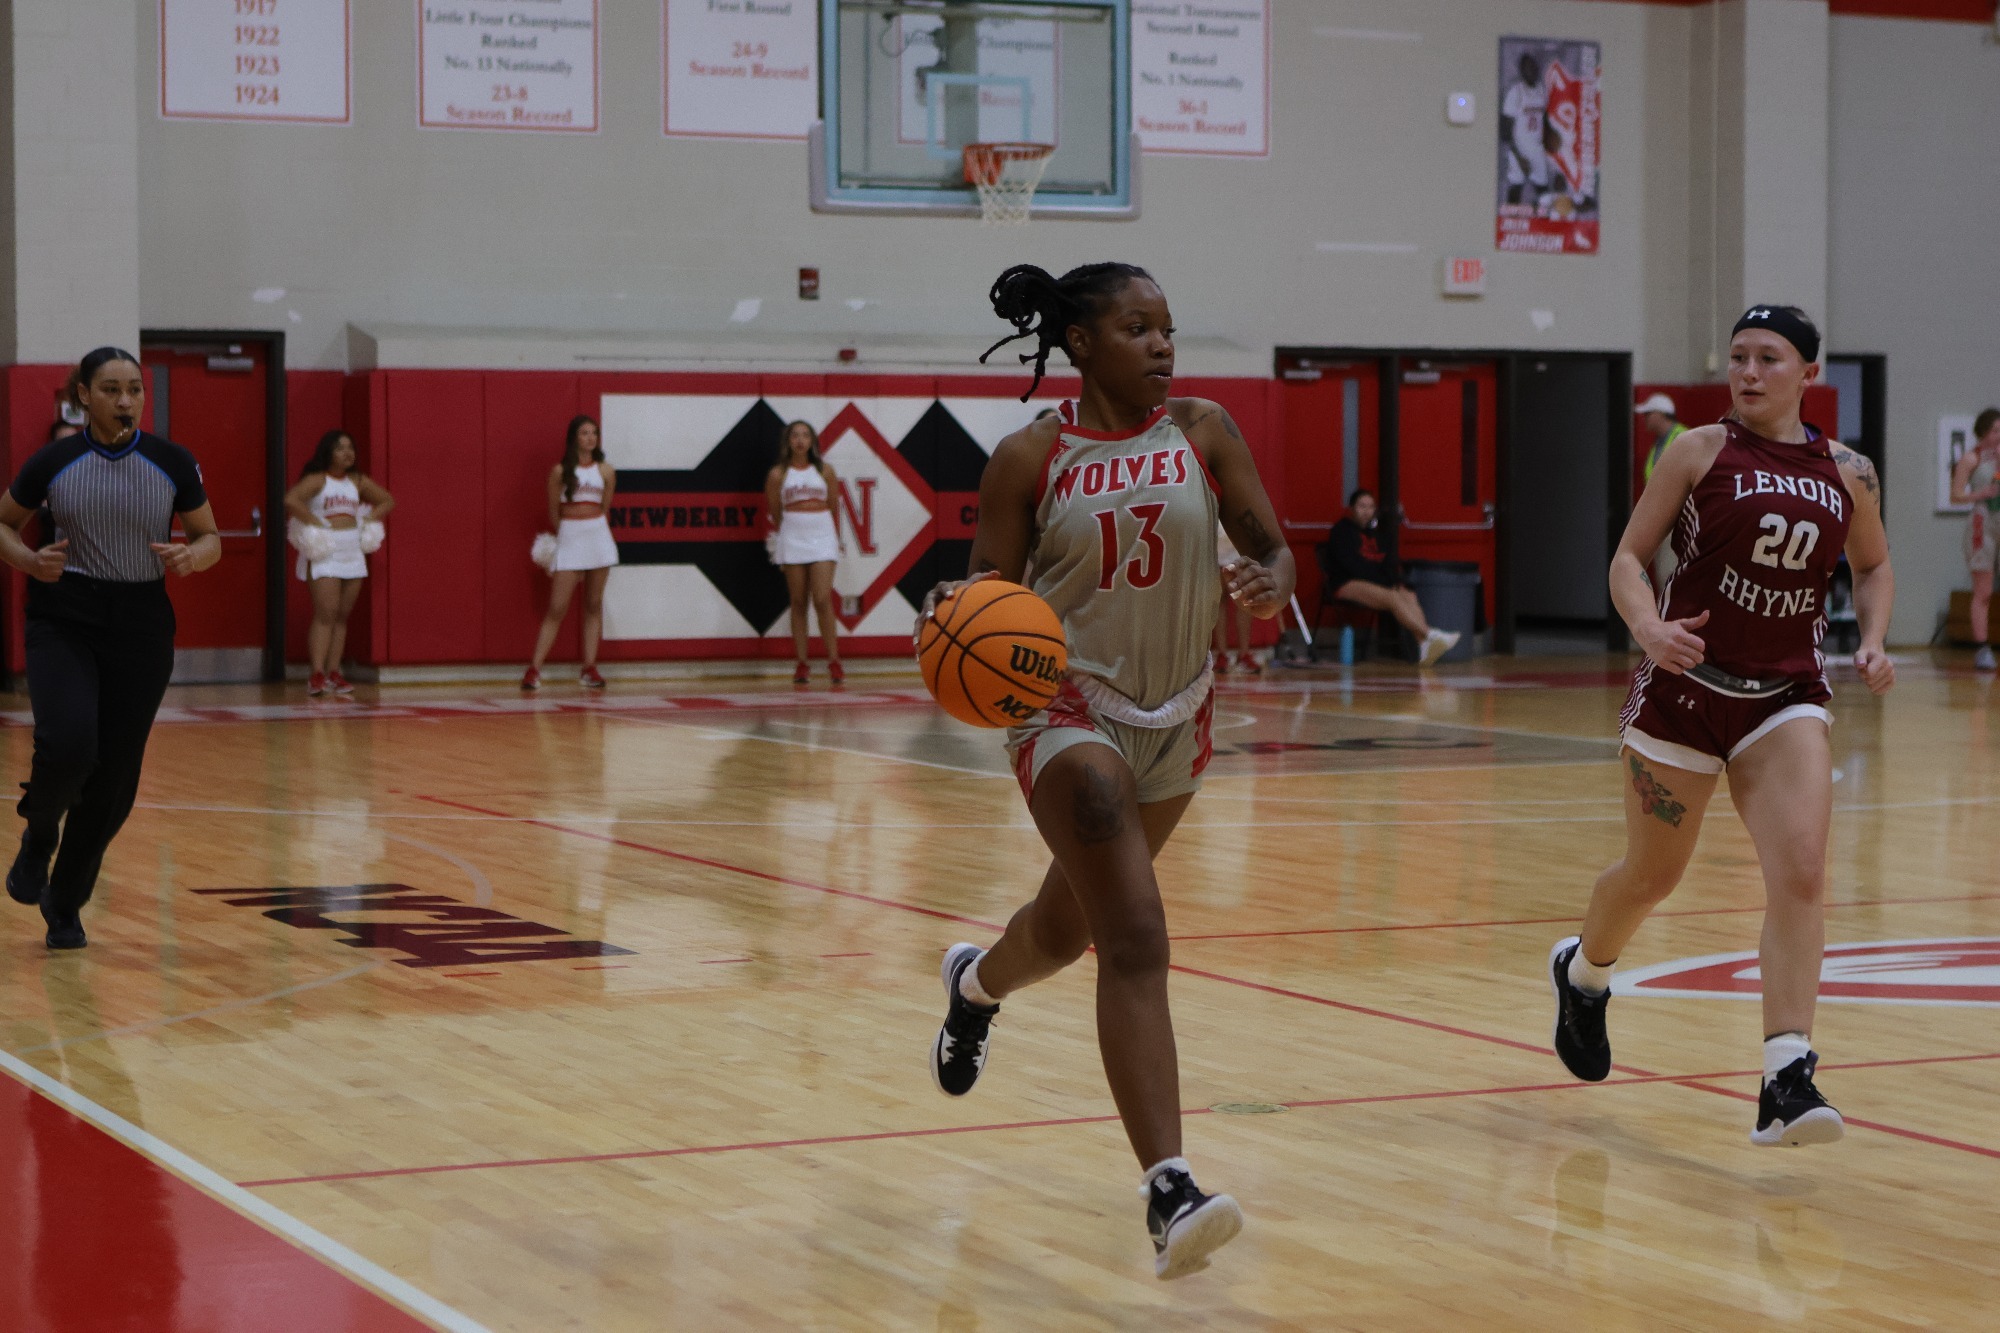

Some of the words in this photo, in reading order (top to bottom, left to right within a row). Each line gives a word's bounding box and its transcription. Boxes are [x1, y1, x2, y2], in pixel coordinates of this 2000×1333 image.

[745, 0, 792, 15] Round
[1130, 4, 1180, 16] ational
[426, 8, 463, 24] Little
[470, 11, 503, 25] Four
[508, 13, 592, 32] Champions
[1146, 21, 1193, 35] Second
[1197, 23, 1239, 37] Round
[234, 25, 280, 46] 1922
[481, 33, 538, 48] Ranked
[235, 55, 280, 76] 1923
[497, 56, 572, 77] Nationally
[1168, 51, 1218, 66] Ranked
[688, 60, 746, 77] Season
[752, 62, 809, 80] Record
[1178, 73, 1243, 92] Nationally
[235, 84, 280, 106] 1924
[446, 104, 506, 121] Season
[512, 105, 572, 123] Record
[1138, 116, 1189, 133] Season
[1195, 118, 1247, 136] Record
[1453, 257, 1480, 283] EXIT
[1053, 448, 1190, 510] WOLVES
[1733, 469, 1844, 523] LENOIR
[608, 506, 758, 528] NEWBERRY
[837, 477, 878, 556] N
[1090, 501, 1168, 592] 13
[1751, 512, 1820, 571] 20
[1718, 563, 1816, 618] RHYNE
